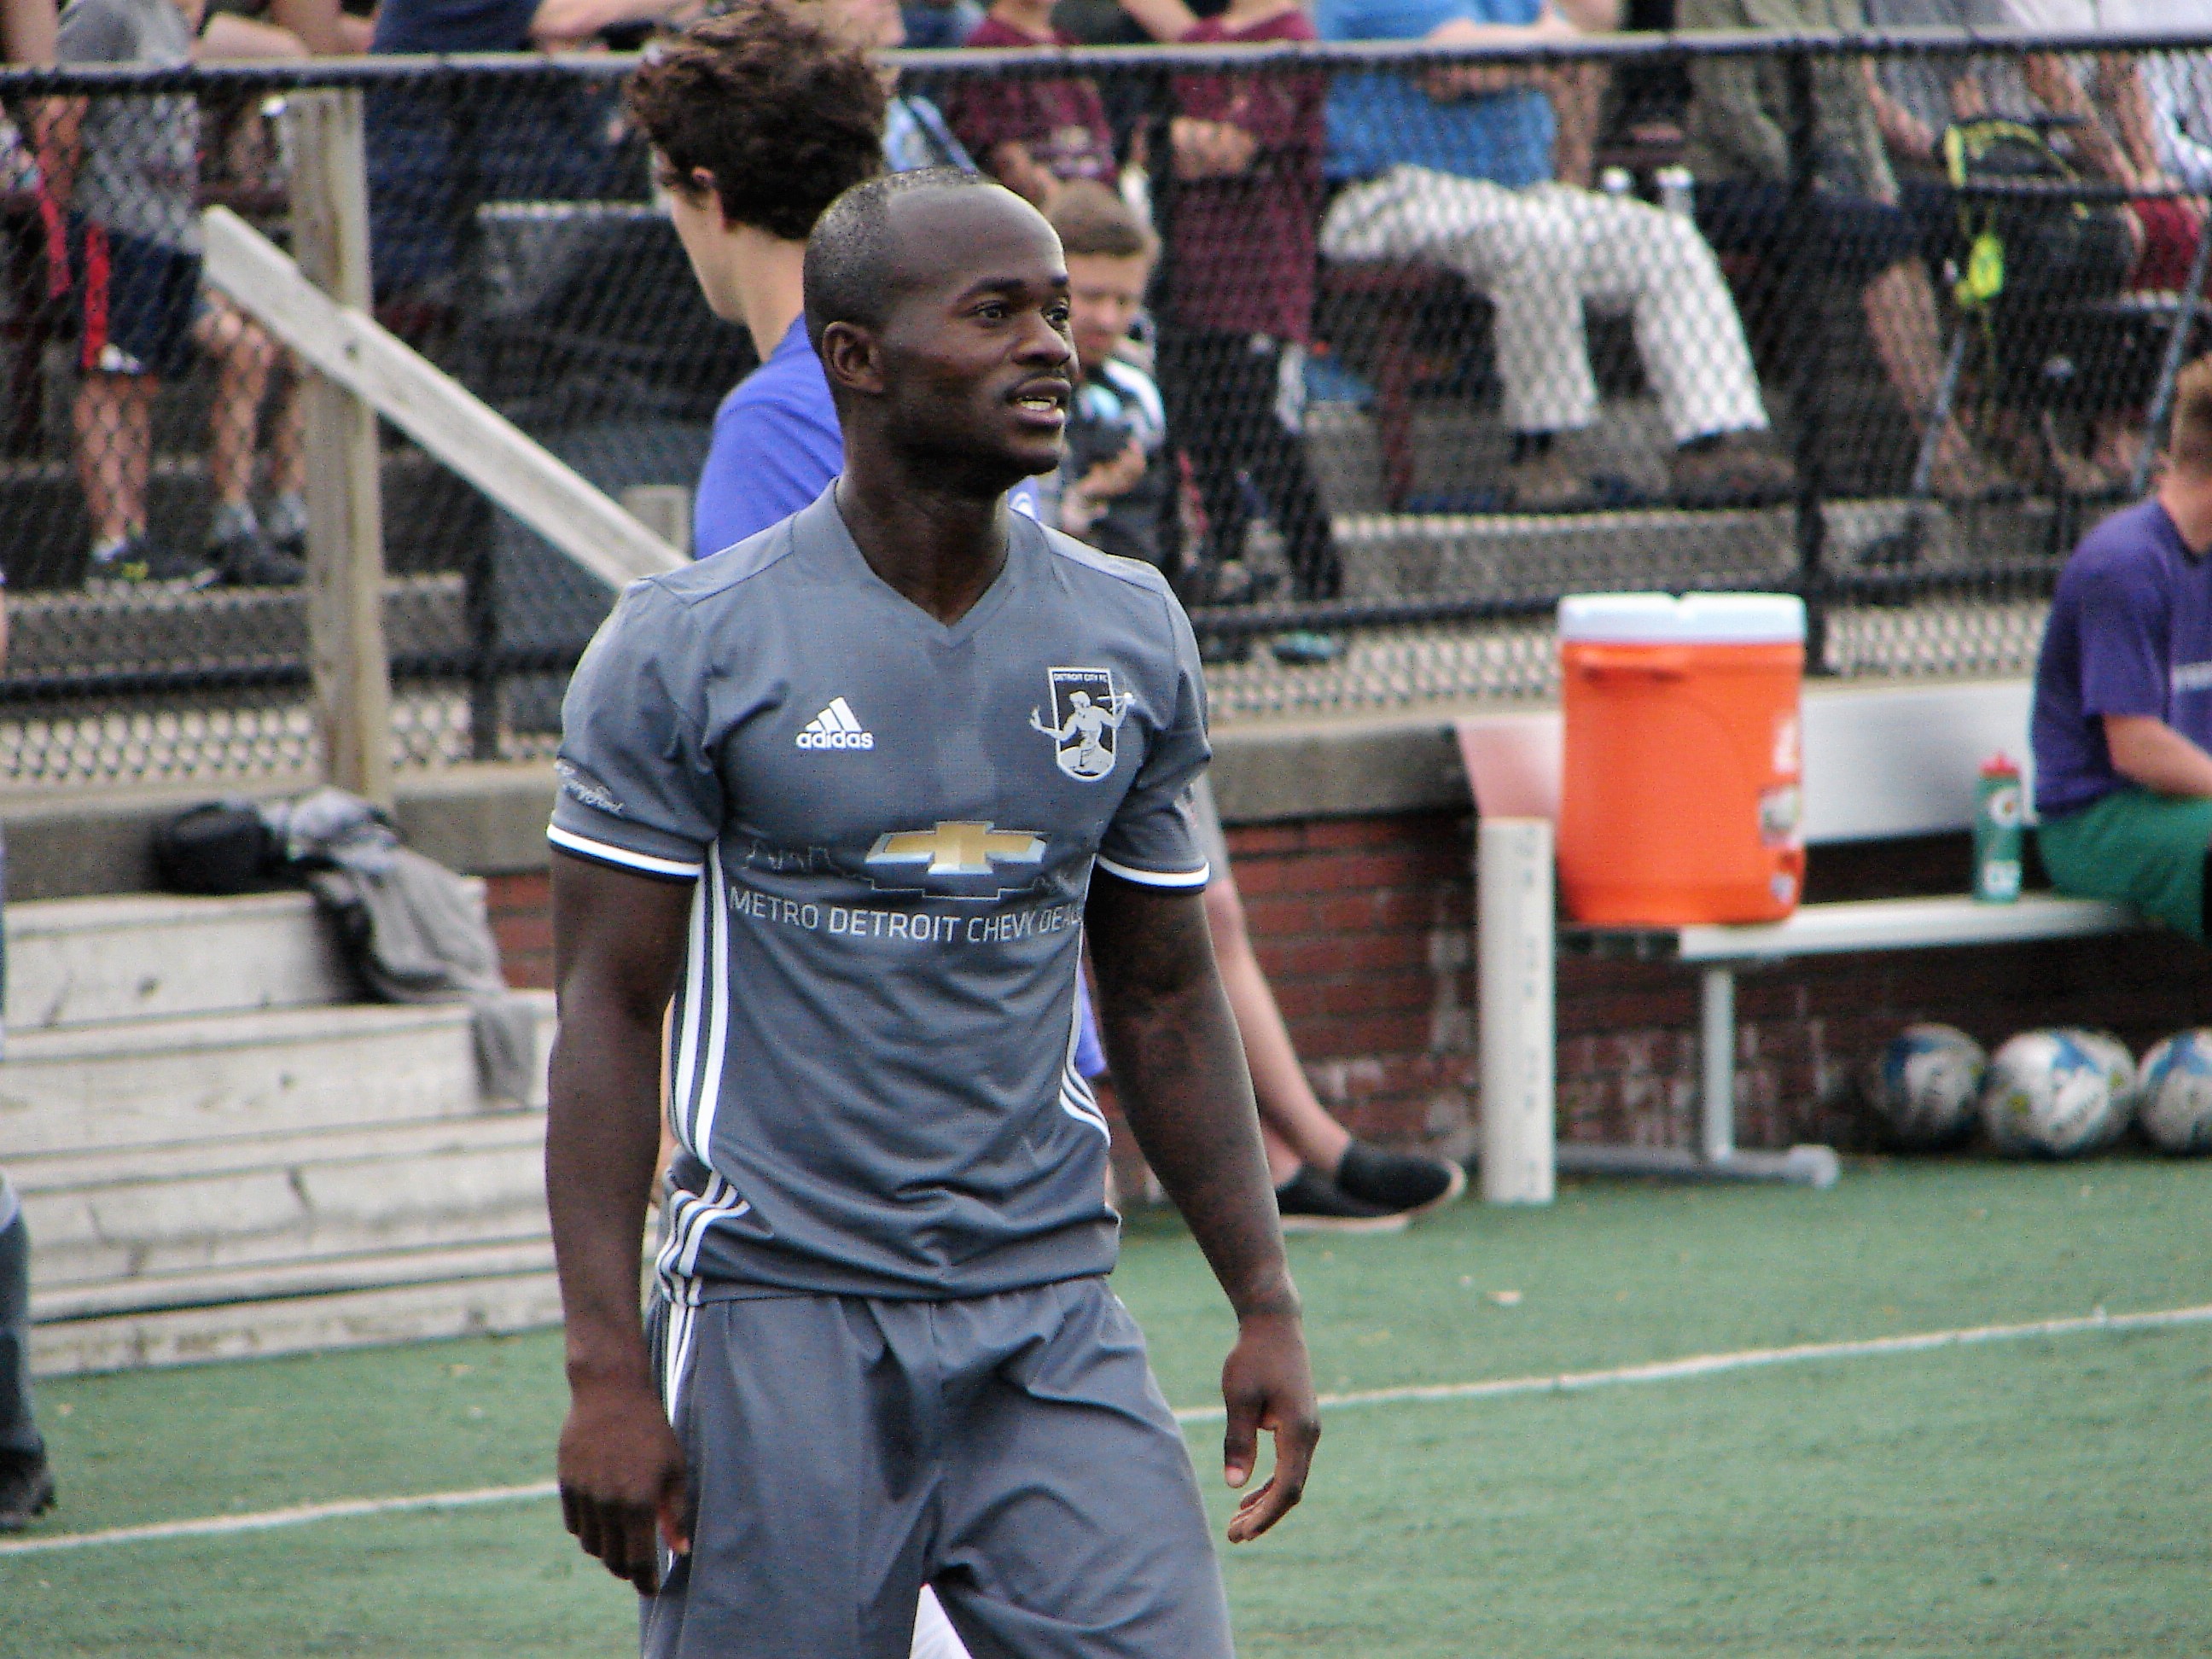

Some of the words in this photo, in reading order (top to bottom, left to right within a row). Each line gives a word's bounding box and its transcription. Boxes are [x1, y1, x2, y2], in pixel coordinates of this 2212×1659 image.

[795, 730, 875, 750] adidas
[730, 885, 819, 931] METRO
[829, 906, 962, 943] DETROIT
[968, 910, 1036, 943] CHEVY
